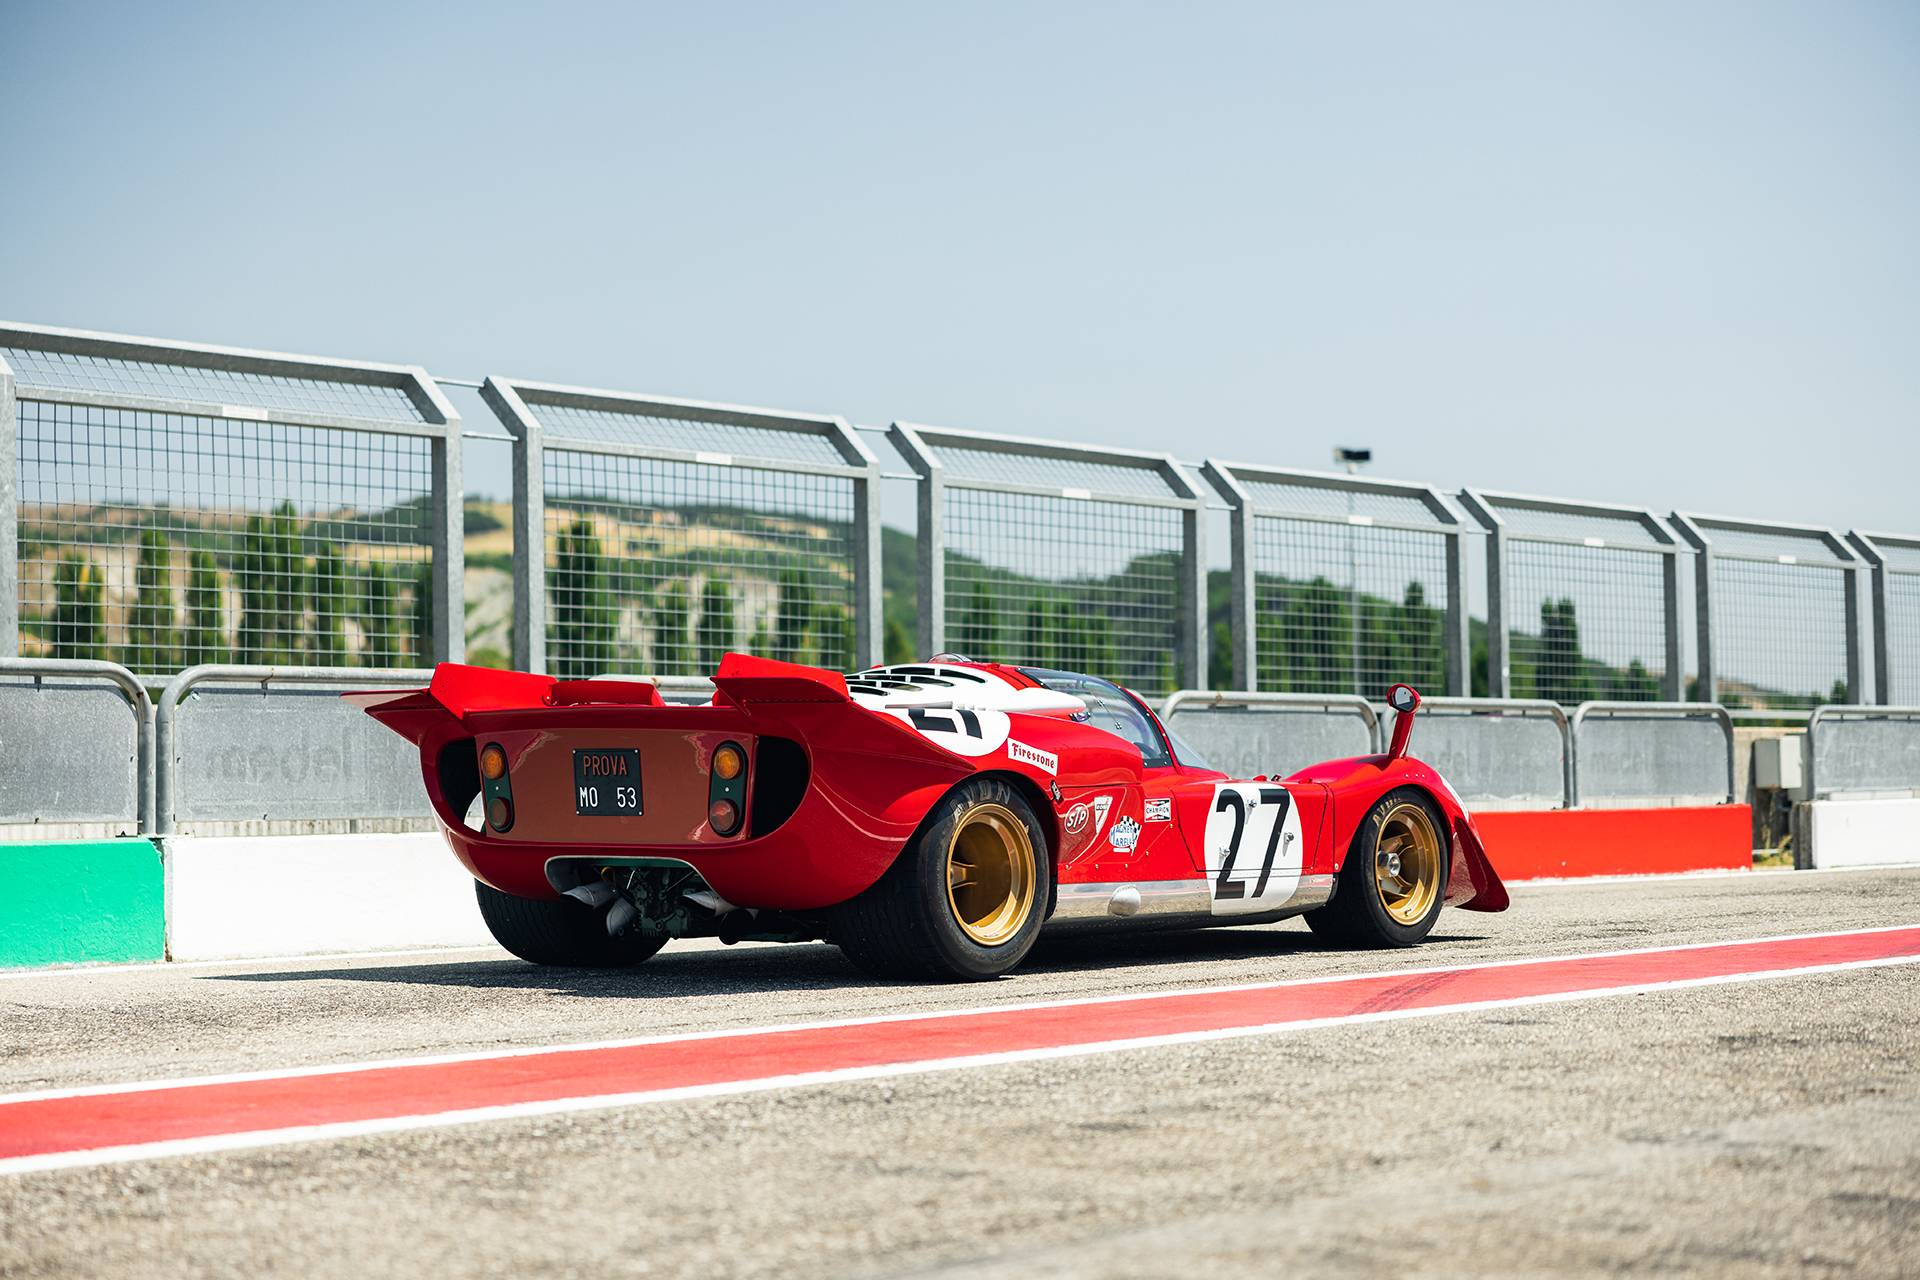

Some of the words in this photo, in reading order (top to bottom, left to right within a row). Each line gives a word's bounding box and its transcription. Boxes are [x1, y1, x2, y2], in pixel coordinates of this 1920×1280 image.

[583, 755, 627, 776] PROVA
[1012, 743, 1055, 769] Firestone
[579, 787, 598, 807] MO
[616, 787, 637, 808] 53
[1066, 806, 1087, 829] STP
[1214, 788, 1290, 900] 27
